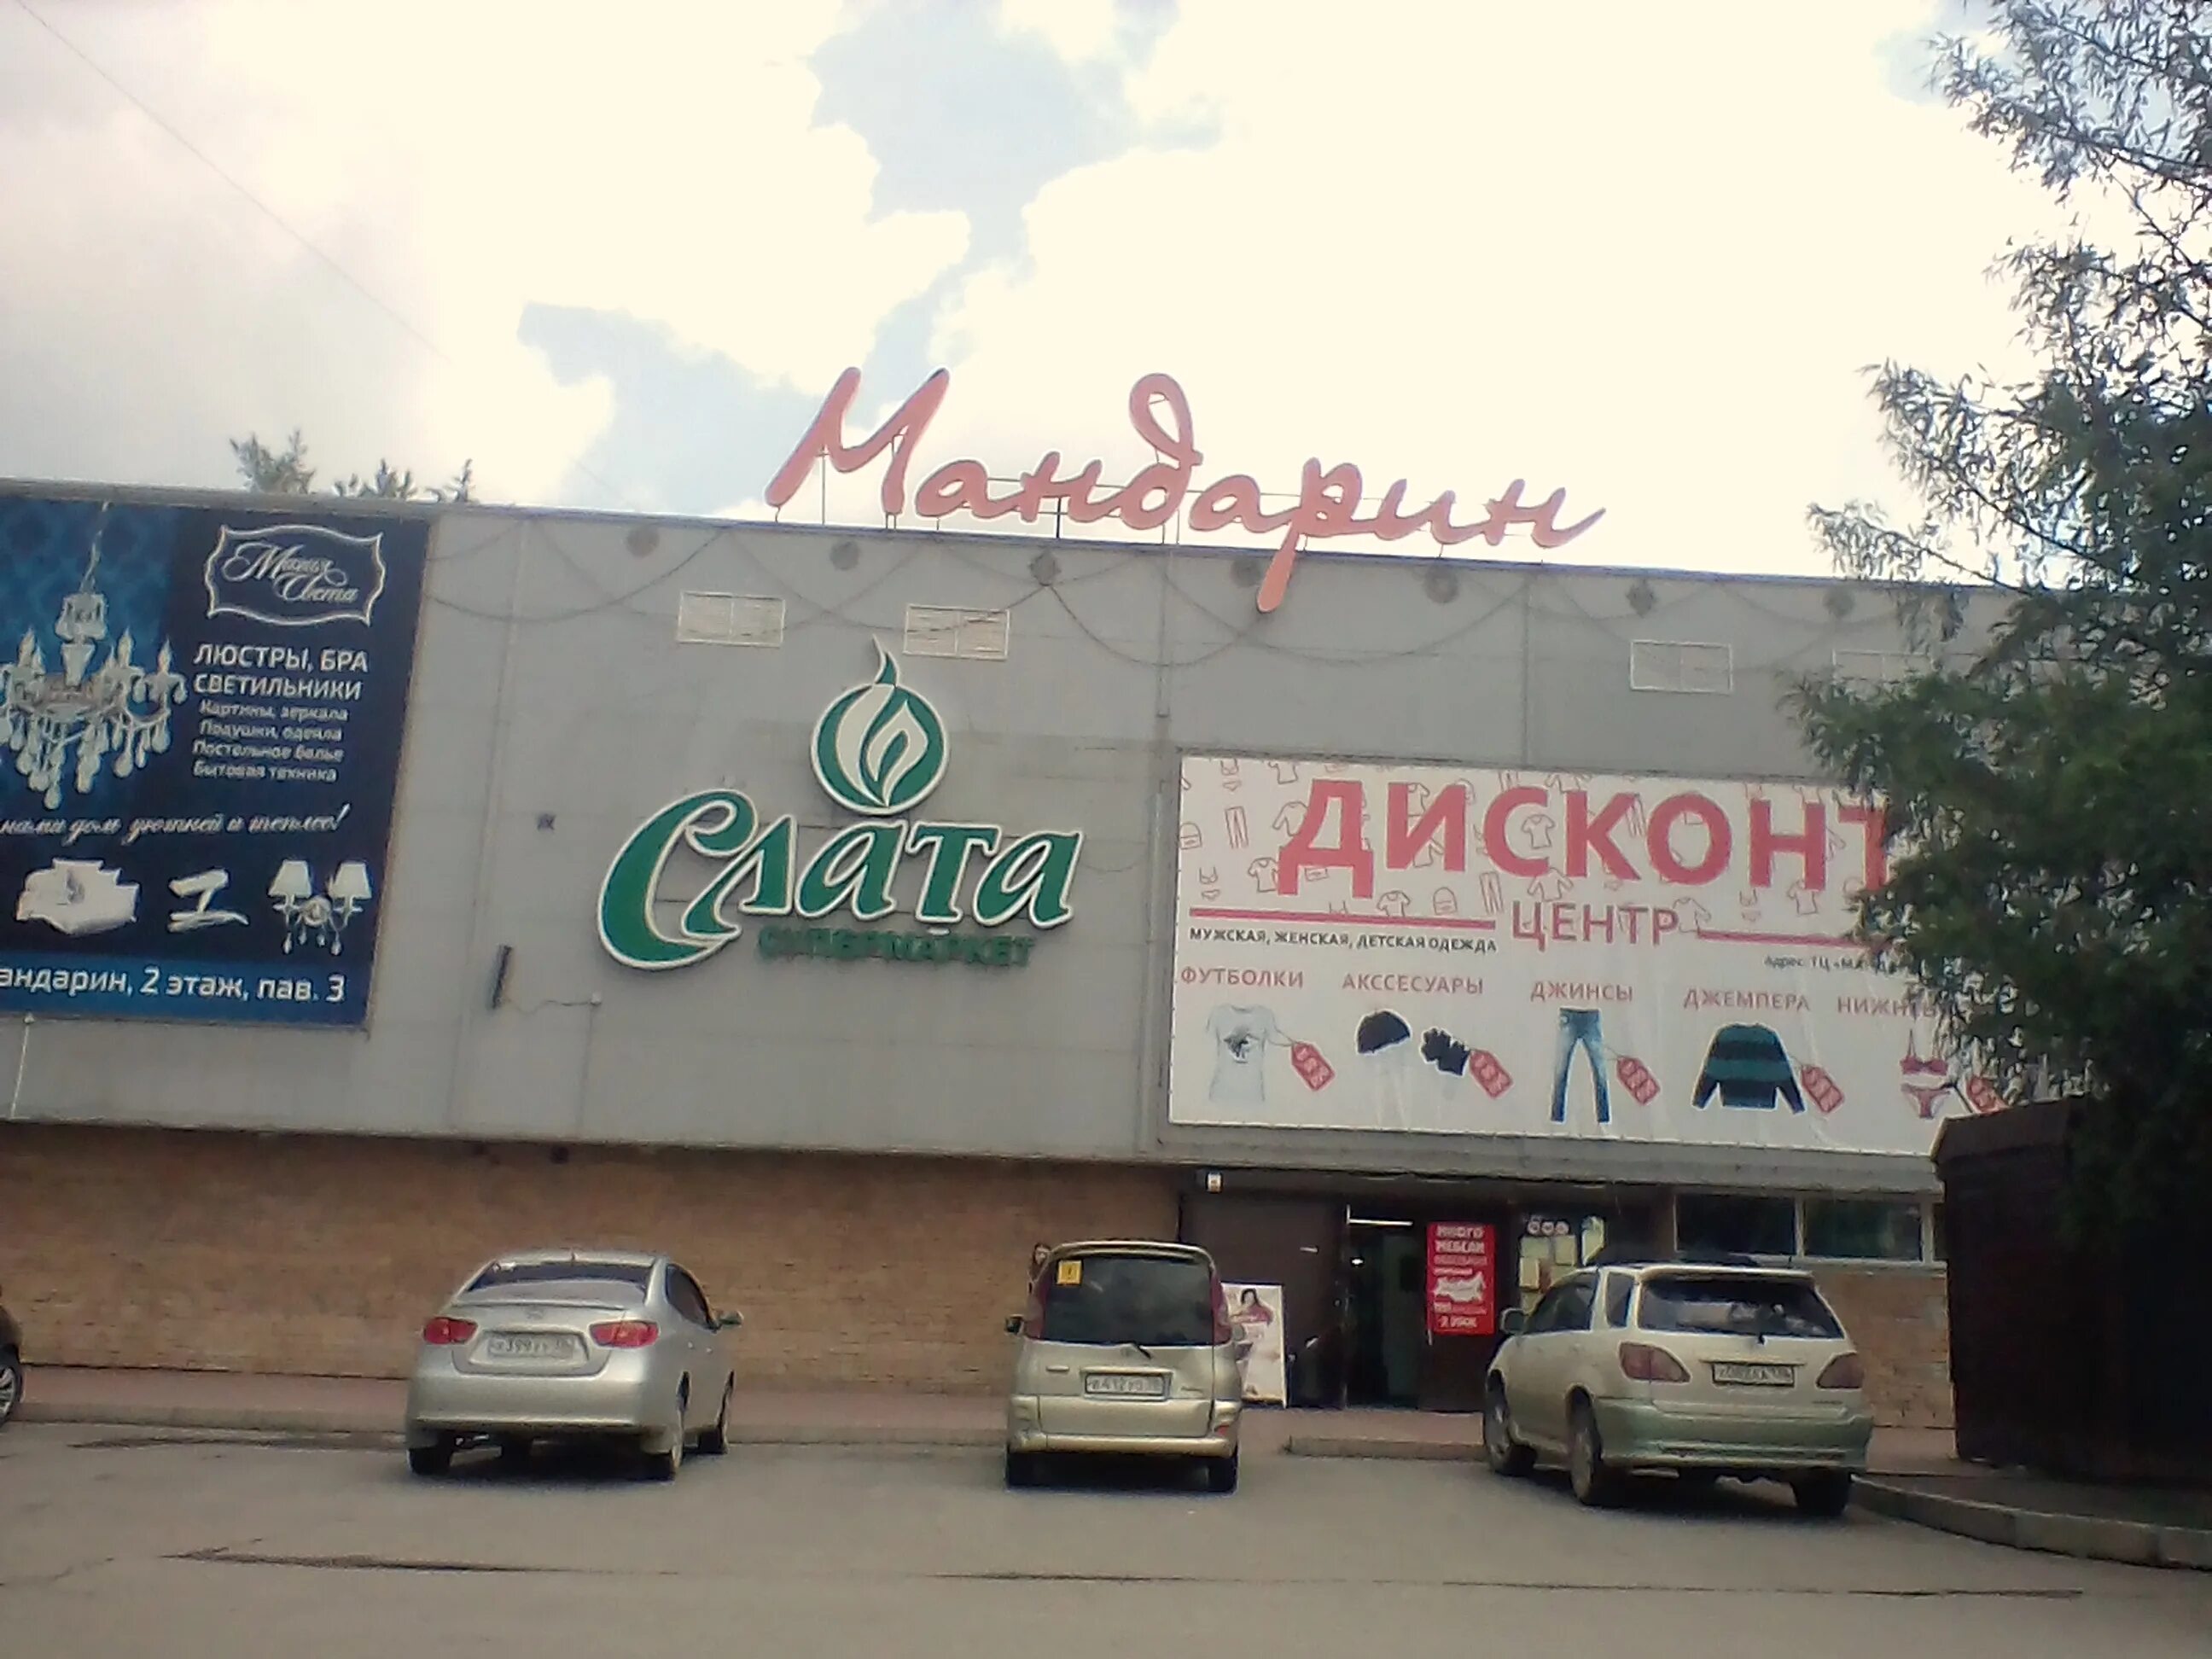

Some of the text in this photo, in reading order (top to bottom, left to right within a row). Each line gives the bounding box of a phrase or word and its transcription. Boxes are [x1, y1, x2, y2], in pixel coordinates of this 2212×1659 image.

[764, 366, 1605, 612] Мандарин
[193, 643, 369, 672] ЛЮСТРЫ, БРА
[193, 673, 363, 700] СВЕТИЛЬНИКИ
[193, 739, 291, 759] Постельное
[269, 767, 338, 782] техника
[1278, 779, 1888, 899] ДИСКОНТ
[1511, 900, 1679, 952] ЦЕНТР
[1190, 928, 1496, 953] МУЖСКАЯ, ЖЕНСКАЯ, ДЕТСКАЯ ОДЕЖДА
[140, 965, 160, 995] 2
[166, 974, 248, 1001] этаж,
[256, 977, 319, 1002] пав.
[326, 974, 346, 1003] 3
[1181, 966, 1303, 988] ФУТБОЛКИ
[1342, 973, 1483, 994] АКССЕСУАРЫ
[1530, 981, 1633, 1003] ДЖИНСЫ
[1684, 988, 1810, 1011] ДЖЕМПЕРА
